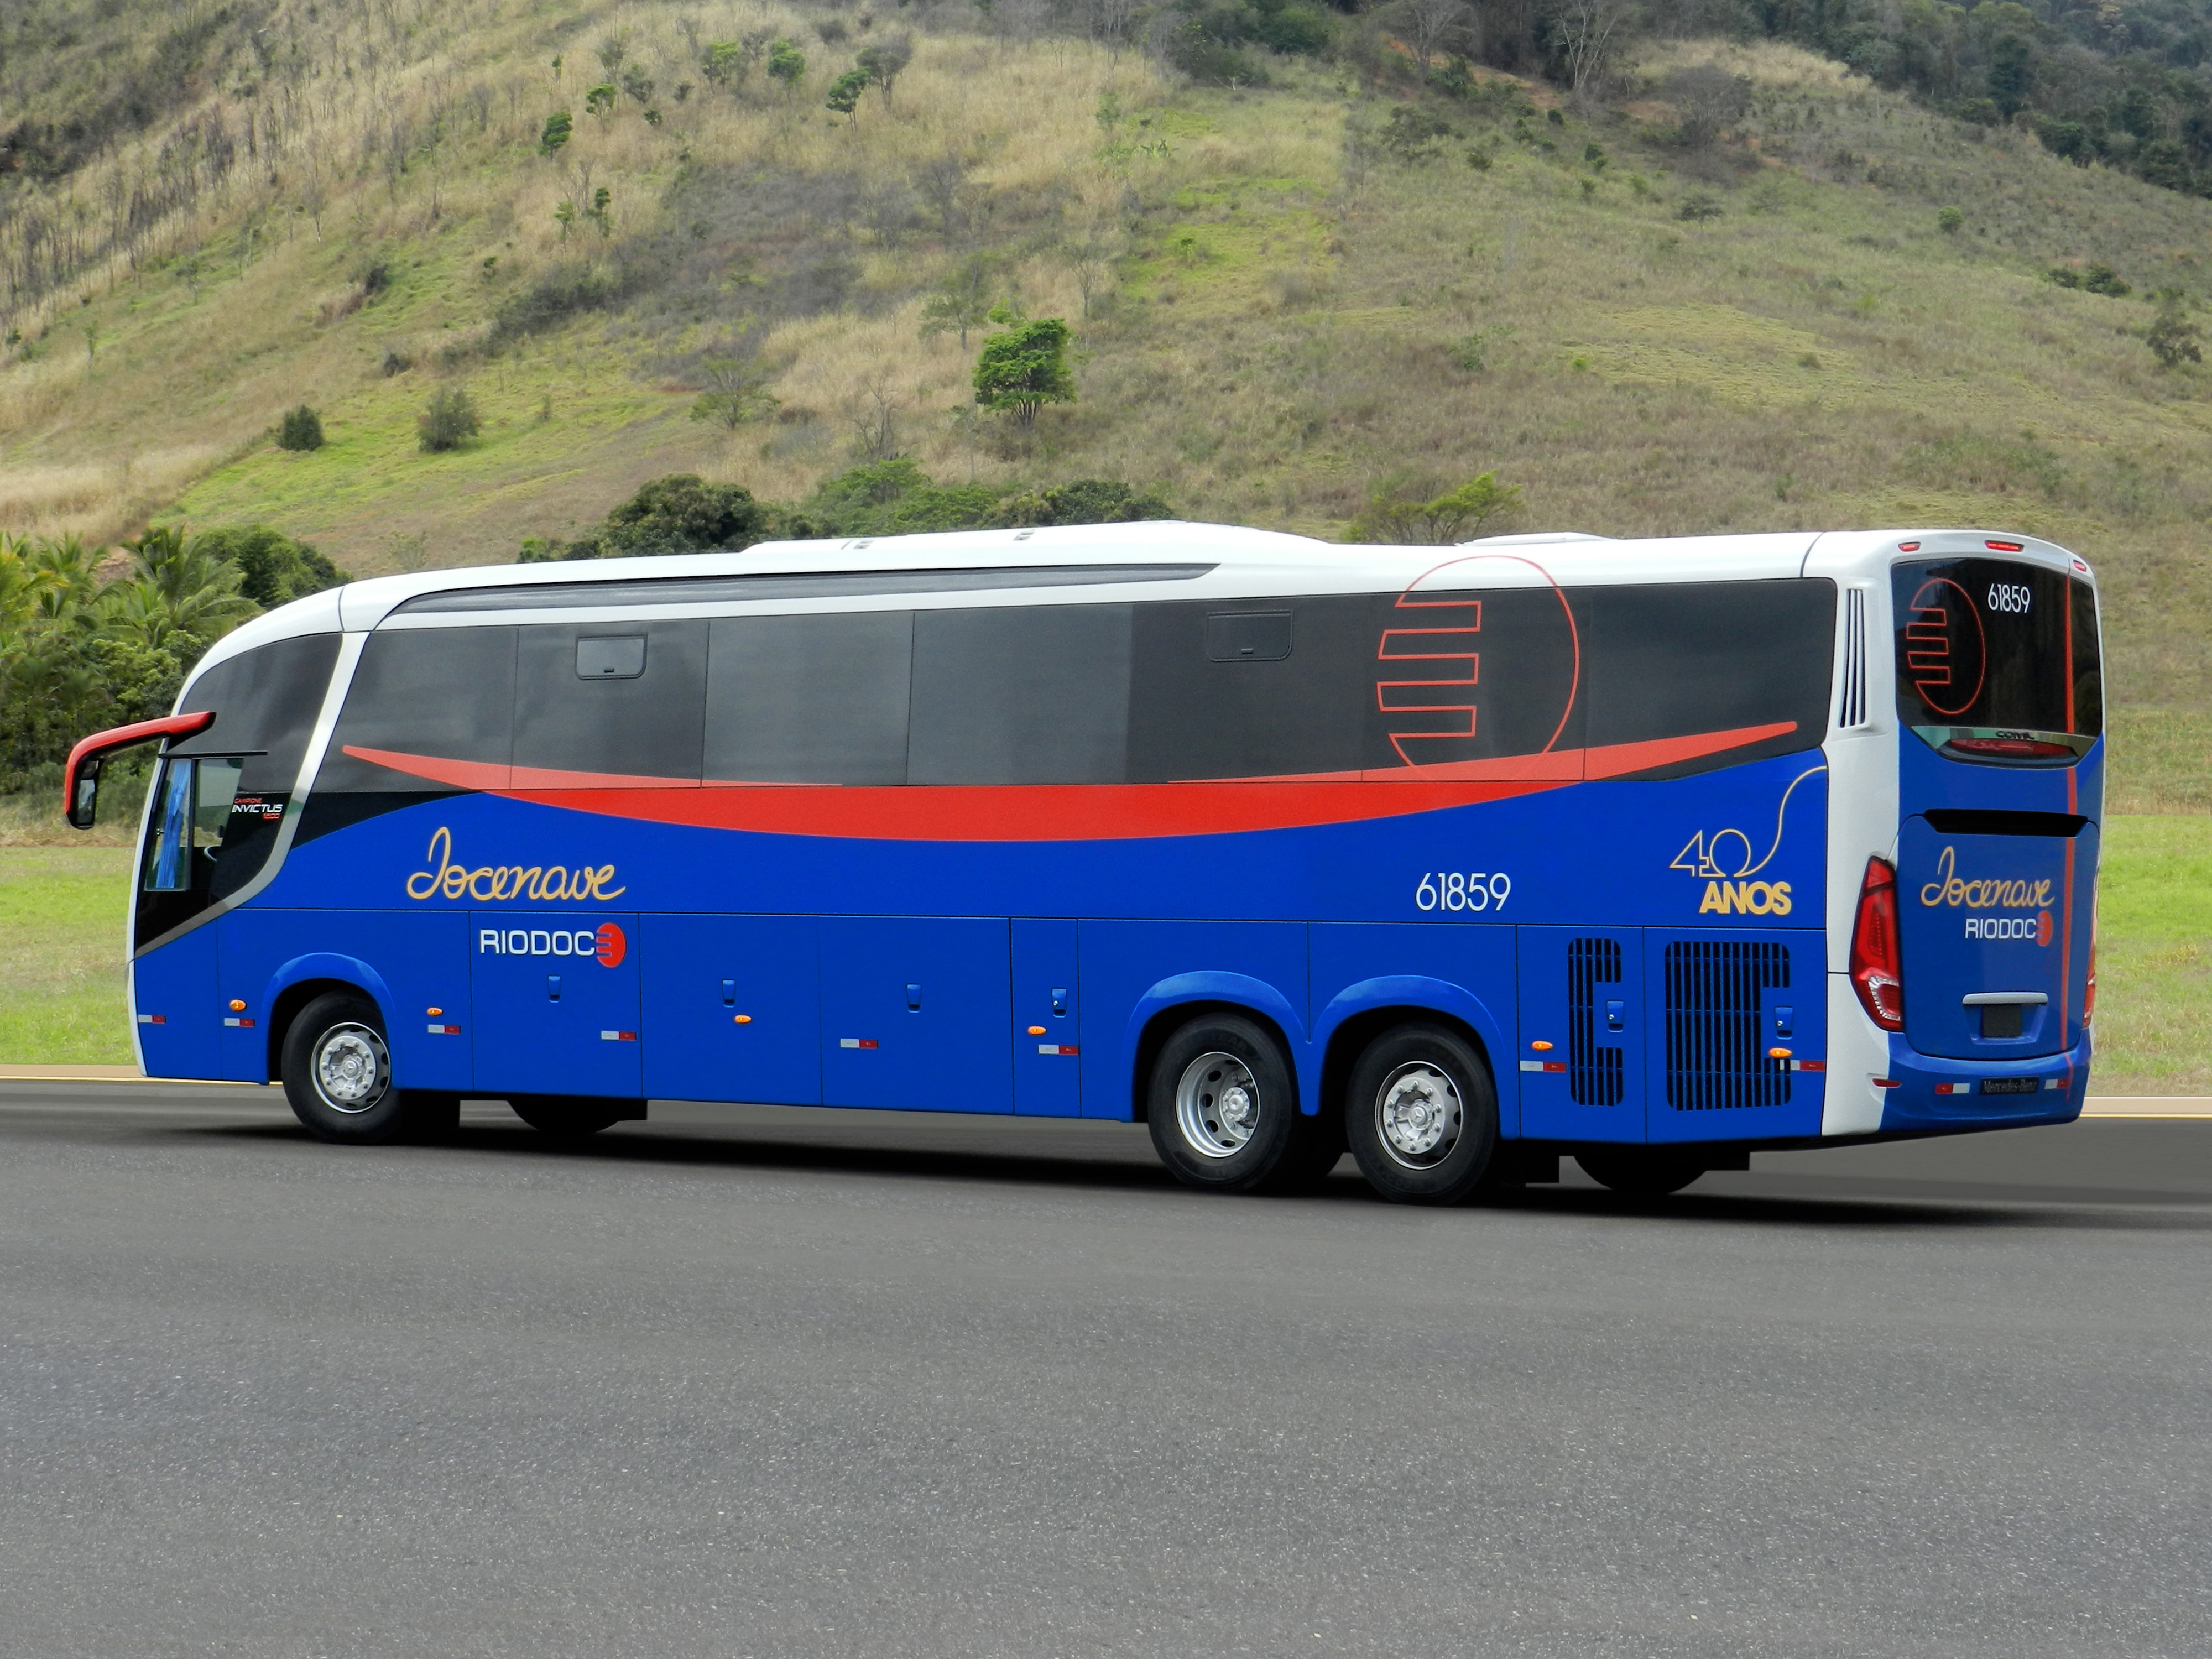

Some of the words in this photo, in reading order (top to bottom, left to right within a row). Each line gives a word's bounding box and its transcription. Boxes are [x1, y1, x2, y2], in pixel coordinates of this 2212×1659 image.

[1987, 583, 2030, 613] 61859
[231, 804, 283, 813] INVICTUS
[406, 826, 626, 901] Jocenave
[1668, 828, 1751, 878] 40
[1415, 872, 1511, 911] 61859
[1921, 846, 2055, 908] Jocenave
[1698, 881, 1792, 916] ANOS
[479, 929, 596, 957] RIODOC
[1965, 918, 2037, 940] RIODOC
